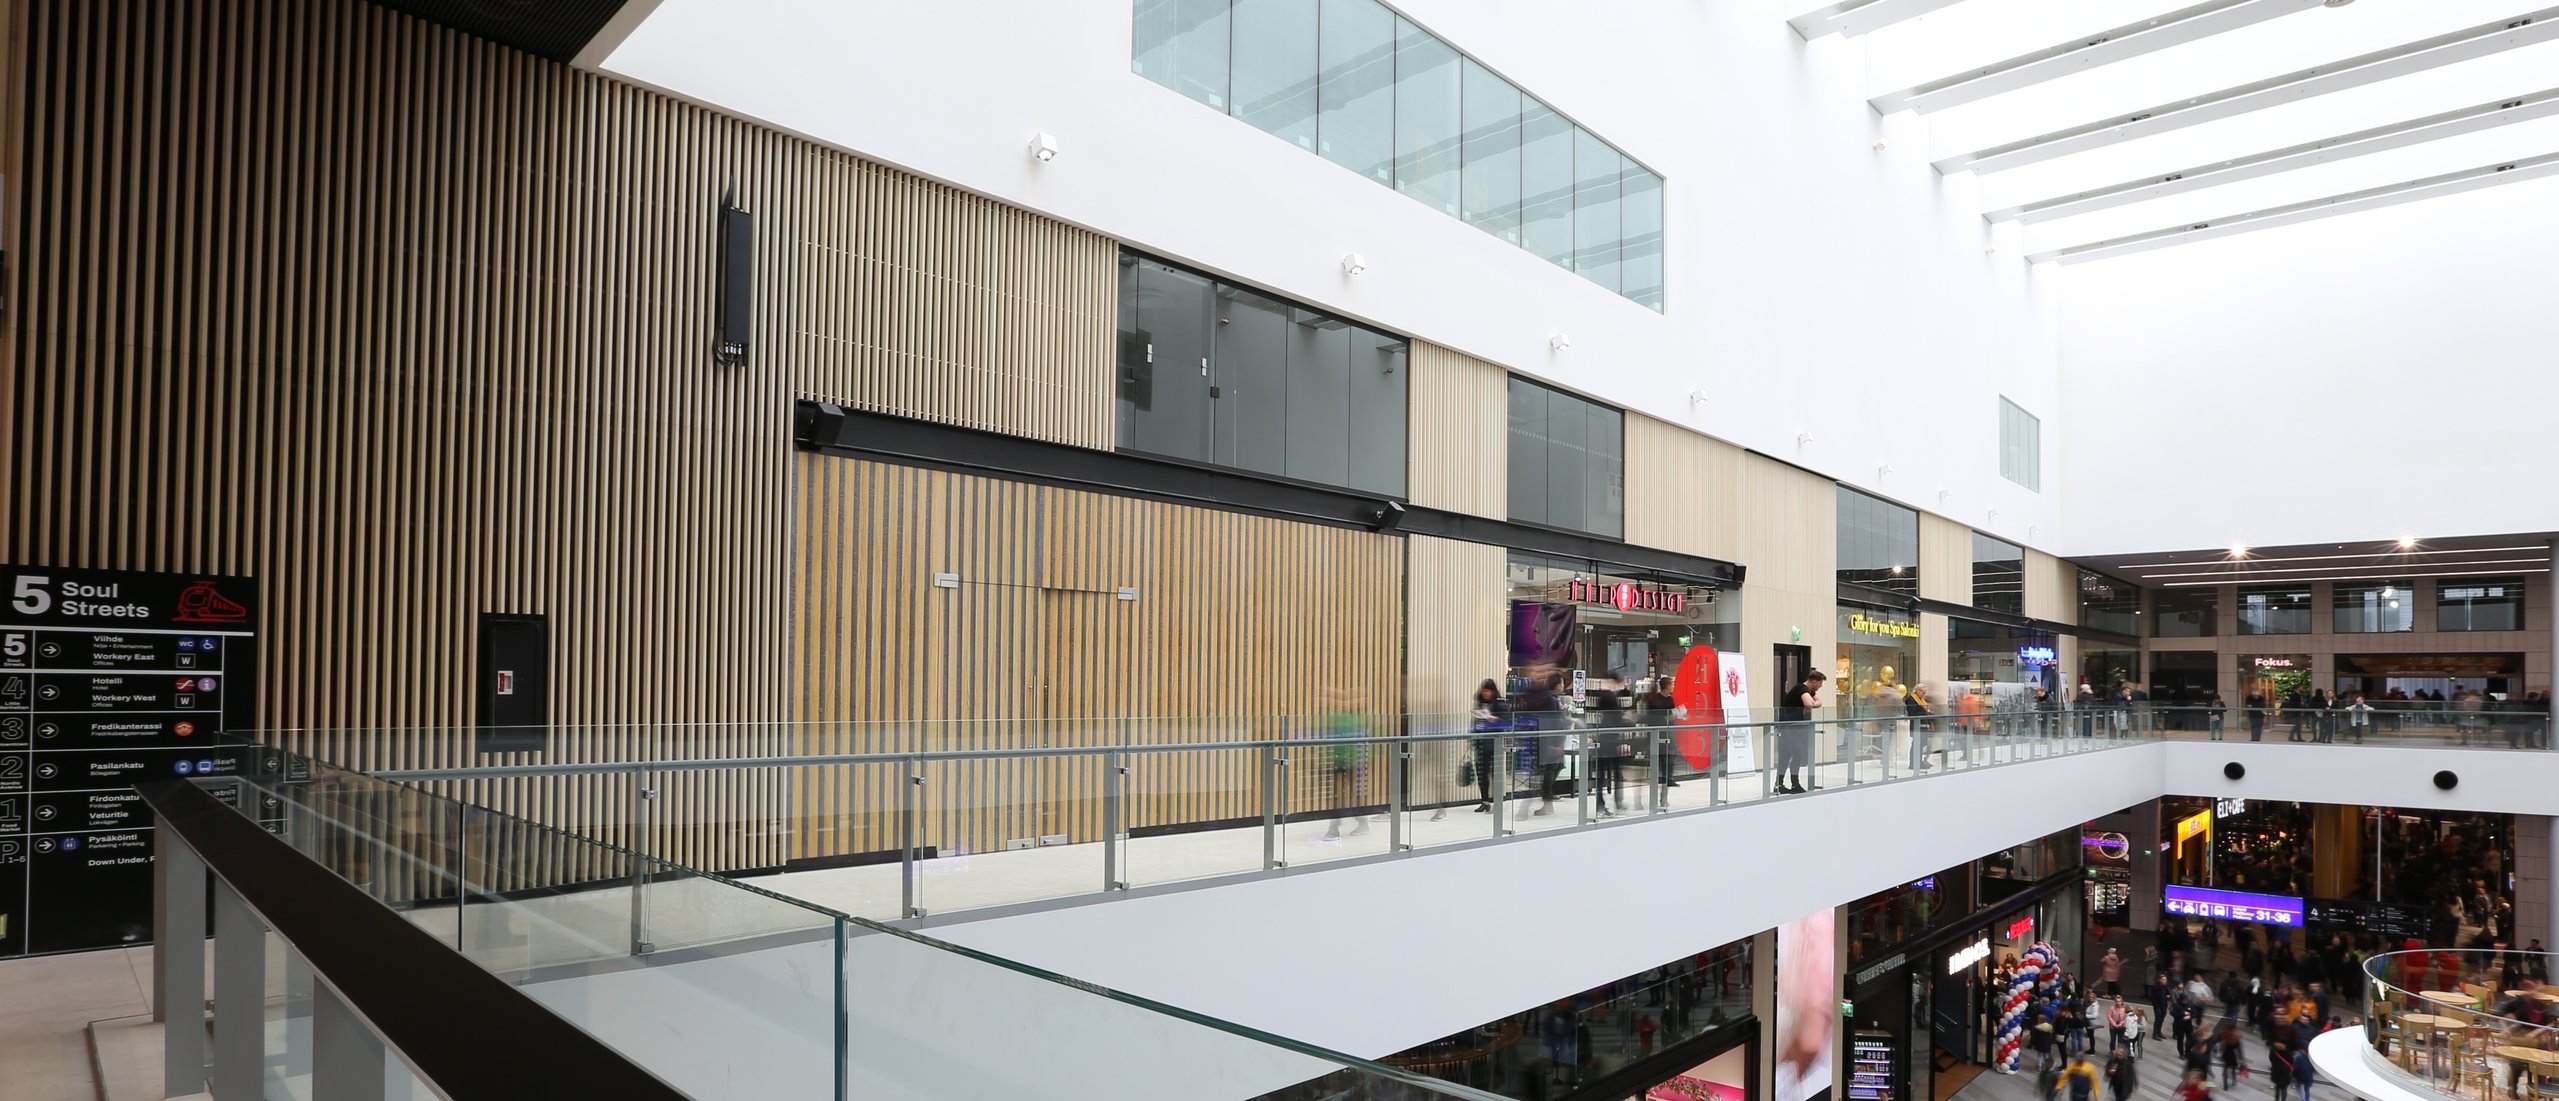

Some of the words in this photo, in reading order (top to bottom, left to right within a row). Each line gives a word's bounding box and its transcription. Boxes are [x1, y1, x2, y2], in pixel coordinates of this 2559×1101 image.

[12, 575, 52, 615] 5
[61, 581, 118, 599] Soul
[1632, 588, 1683, 613] DESIGN
[61, 600, 150, 618] Streets
[4, 633, 26, 656] 5
[93, 635, 124, 643] Viihde
[93, 653, 132, 662] Workery
[181, 656, 191, 665] W
[2254, 658, 2294, 667] Fokus.
[1, 676, 26, 700] 4
[92, 695, 131, 704] Workery
[180, 697, 190, 705] W
[1, 717, 24, 740] 3
[0, 756, 23, 779] 2
[89, 795, 140, 803] Firdonkatu
[0, 798, 21, 821] 1
[89, 811, 129, 819] Veturitie
[88, 834, 138, 844] Pysäköinti
[88, 858, 115, 867] Down
[2255, 910, 2291, 923] 31-36
